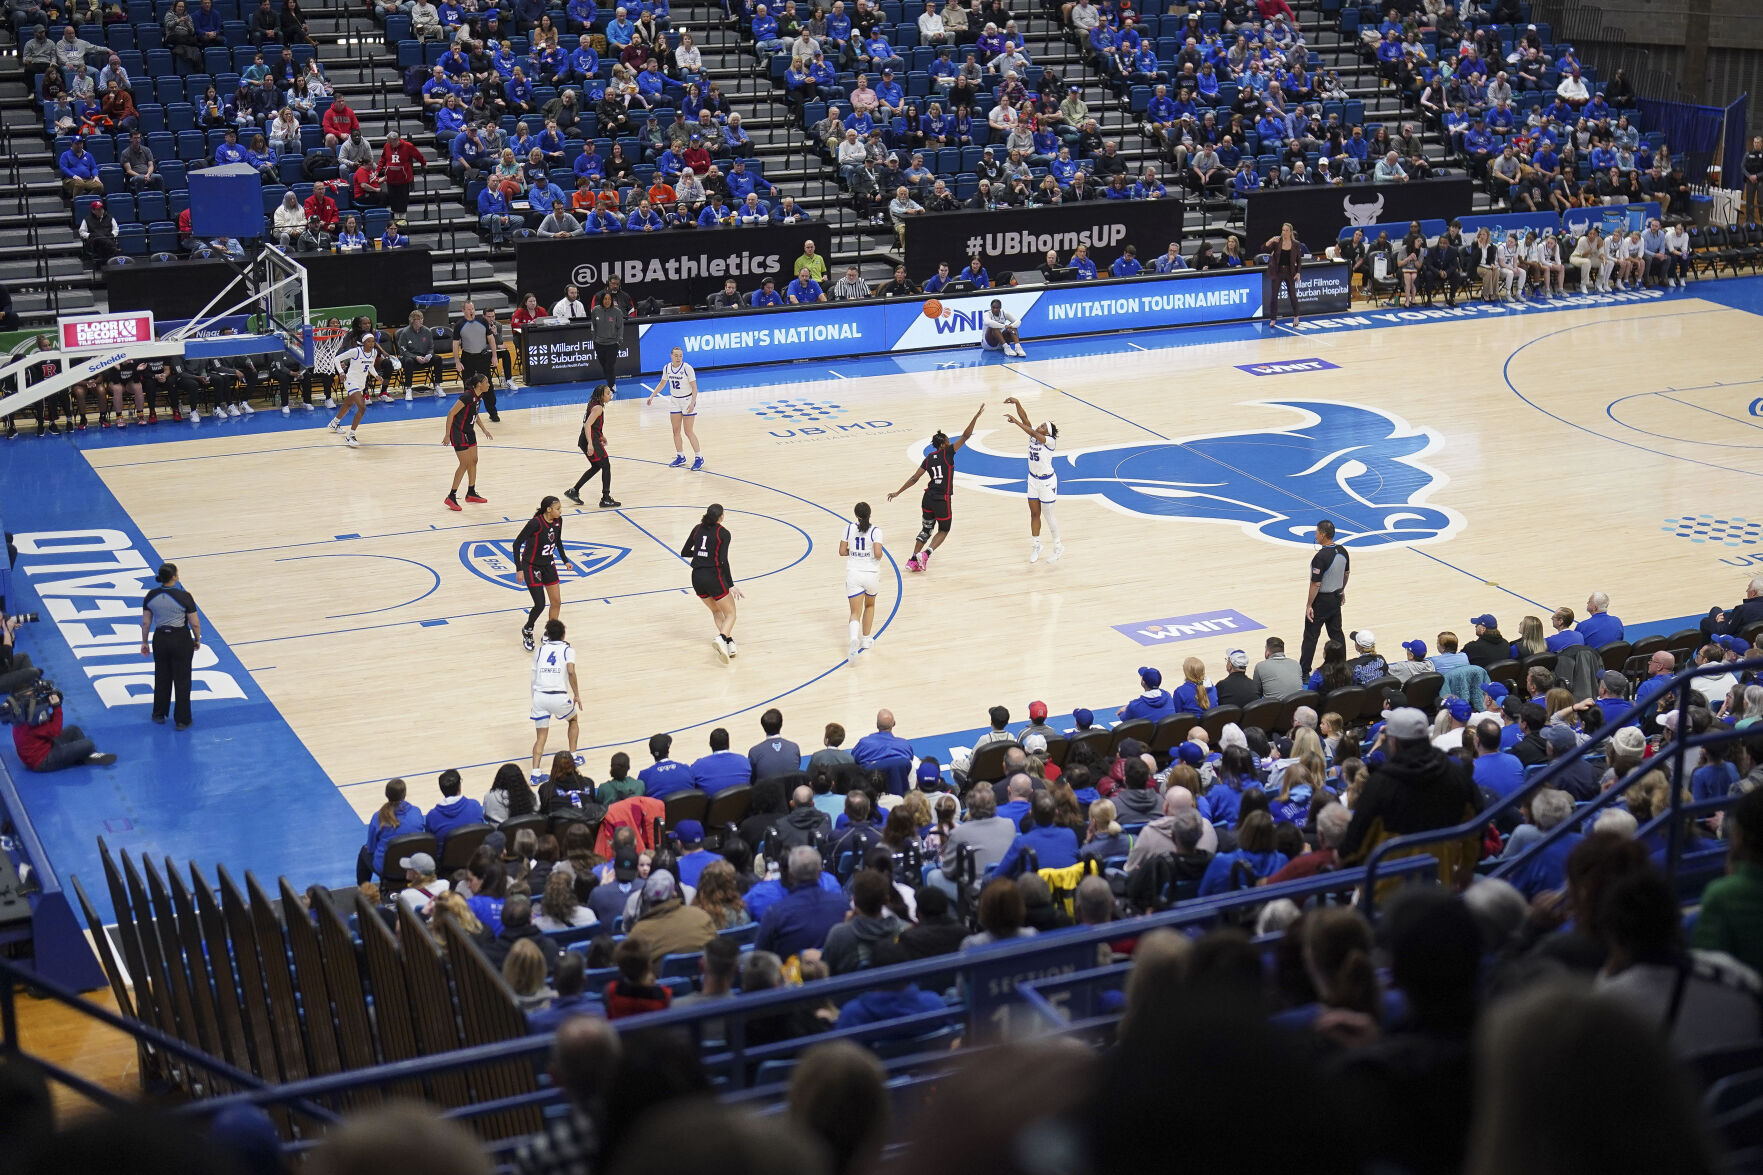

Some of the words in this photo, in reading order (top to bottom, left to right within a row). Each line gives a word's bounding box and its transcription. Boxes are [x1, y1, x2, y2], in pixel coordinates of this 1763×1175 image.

[391, 154, 401, 163] R
[966, 223, 1127, 257] #UBhornsUP
[571, 251, 781, 288] @UBAthletics
[1313, 278, 1340, 287] Fillmore
[1322, 285, 1349, 296] Hospital
[1048, 297, 1140, 320] INVITATION
[1142, 288, 1250, 312] TOURNAMENT
[77, 320, 119, 333] FLOOR
[934, 309, 990, 335] WNI
[1285, 316, 1372, 331] NEW
[77, 329, 119, 341] DECOR
[684, 329, 771, 352] WOMEN'S
[774, 322, 862, 345] NATIONAL
[551, 341, 580, 354] Millard
[88, 351, 127, 373] Schelde
[551, 352, 593, 364] Suburban
[42, 364, 57, 377] R
[1250, 361, 1323, 374] WNIT
[671, 380, 681, 390] 12
[931, 465, 944, 480] 11
[541, 543, 556, 556] 22
[700, 535, 708, 550] 1
[855, 536, 866, 551] 11
[1136, 617, 1240, 640] WNIT
[546, 651, 557, 666] 4
